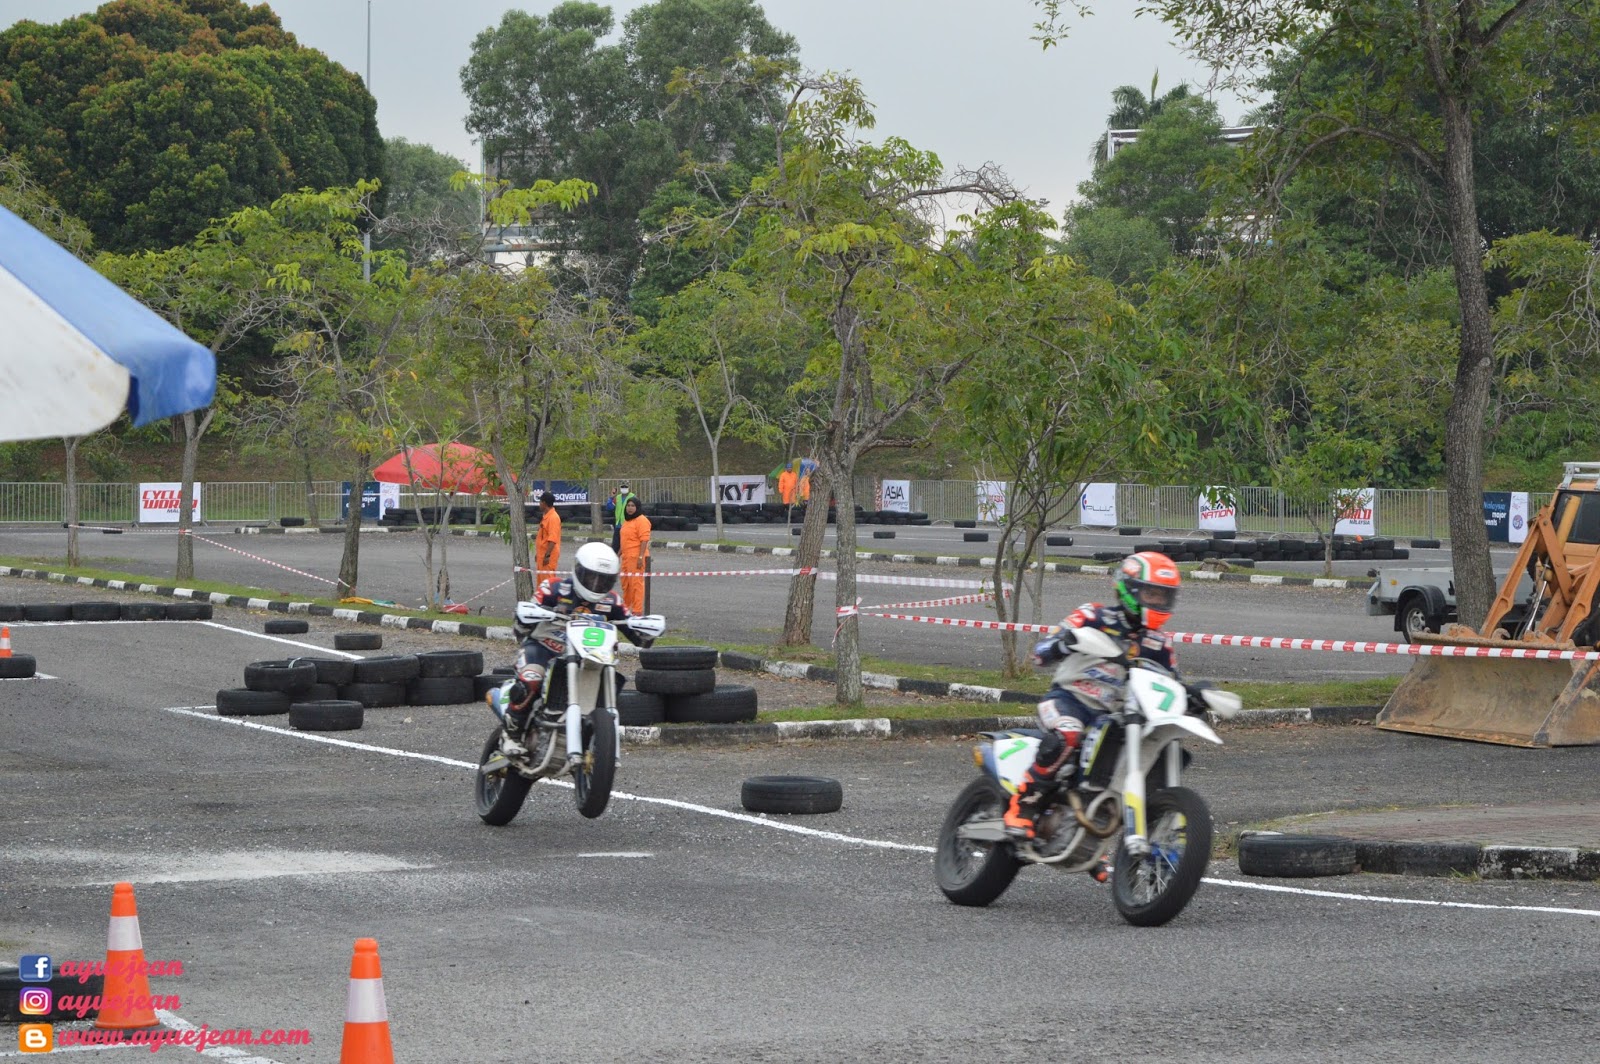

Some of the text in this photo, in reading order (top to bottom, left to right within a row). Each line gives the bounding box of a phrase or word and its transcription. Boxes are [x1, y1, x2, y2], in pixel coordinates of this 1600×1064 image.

[143, 490, 182, 500] CYCL
[884, 485, 905, 500] ASIA
[1201, 508, 1234, 520] NATION
[582, 627, 605, 647] 9
[1152, 681, 1176, 711] 7
